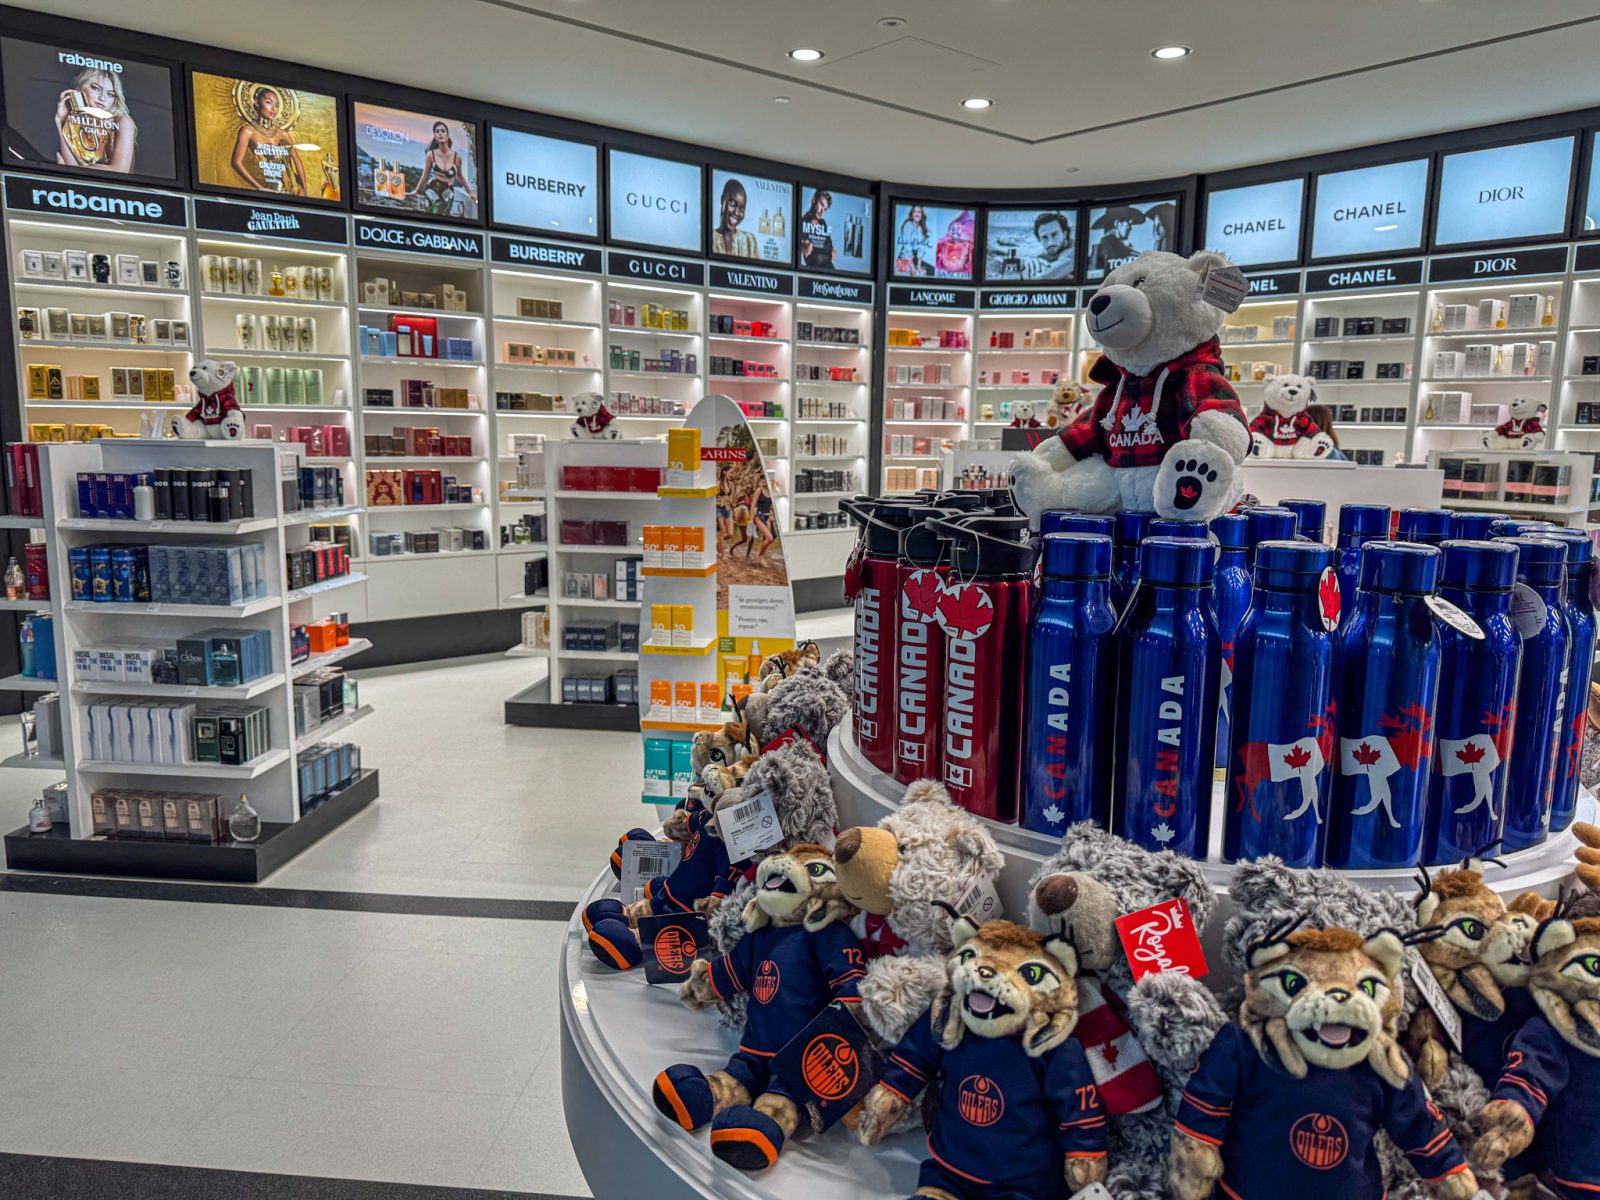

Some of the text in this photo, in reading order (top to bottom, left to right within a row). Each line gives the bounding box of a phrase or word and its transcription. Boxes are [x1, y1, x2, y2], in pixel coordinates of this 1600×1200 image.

[58, 52, 123, 74] rabanne
[69, 114, 120, 130] MILLION
[506, 172, 586, 198] BURBERRY
[754, 179, 790, 195] VALENTINO
[1478, 185, 1525, 204] DIOR
[32, 189, 163, 218] rabanne
[626, 192, 688, 215] GUCCI
[1333, 201, 1407, 222] CHANEL
[247, 219, 301, 230] GAULTIER
[250, 210, 273, 222] Jean
[802, 221, 833, 237] MYSLF
[1223, 217, 1286, 236] CHANEL
[360, 226, 405, 245] DOLCE
[412, 232, 479, 254] GABBANA
[509, 243, 585, 266] BURBERRY
[628, 259, 686, 279] GUCCI
[1473, 257, 1518, 275] DIOR
[727, 271, 778, 290] VALENTINO
[1248, 279, 1279, 292] NEL
[1328, 268, 1397, 287] CHANEL
[989, 292, 1068, 306] GIORGIO ARMANI
[1108, 431, 1165, 448] CANADA
[702, 449, 747, 460] ARINS
[671, 461, 685, 472] 30
[860, 586, 881, 714] CANADA
[900, 621, 928, 738] CANAD
[946, 637, 977, 760] CANAD
[1045, 663, 1072, 800] CANADA
[1153, 674, 1186, 818] CANADA
[842, 947, 865, 966] 72
[804, 1041, 850, 1096] OILERS
[960, 1094, 1000, 1122] OILERS
[1075, 1084, 1099, 1112] 72
[1296, 1130, 1343, 1166] OILERS
